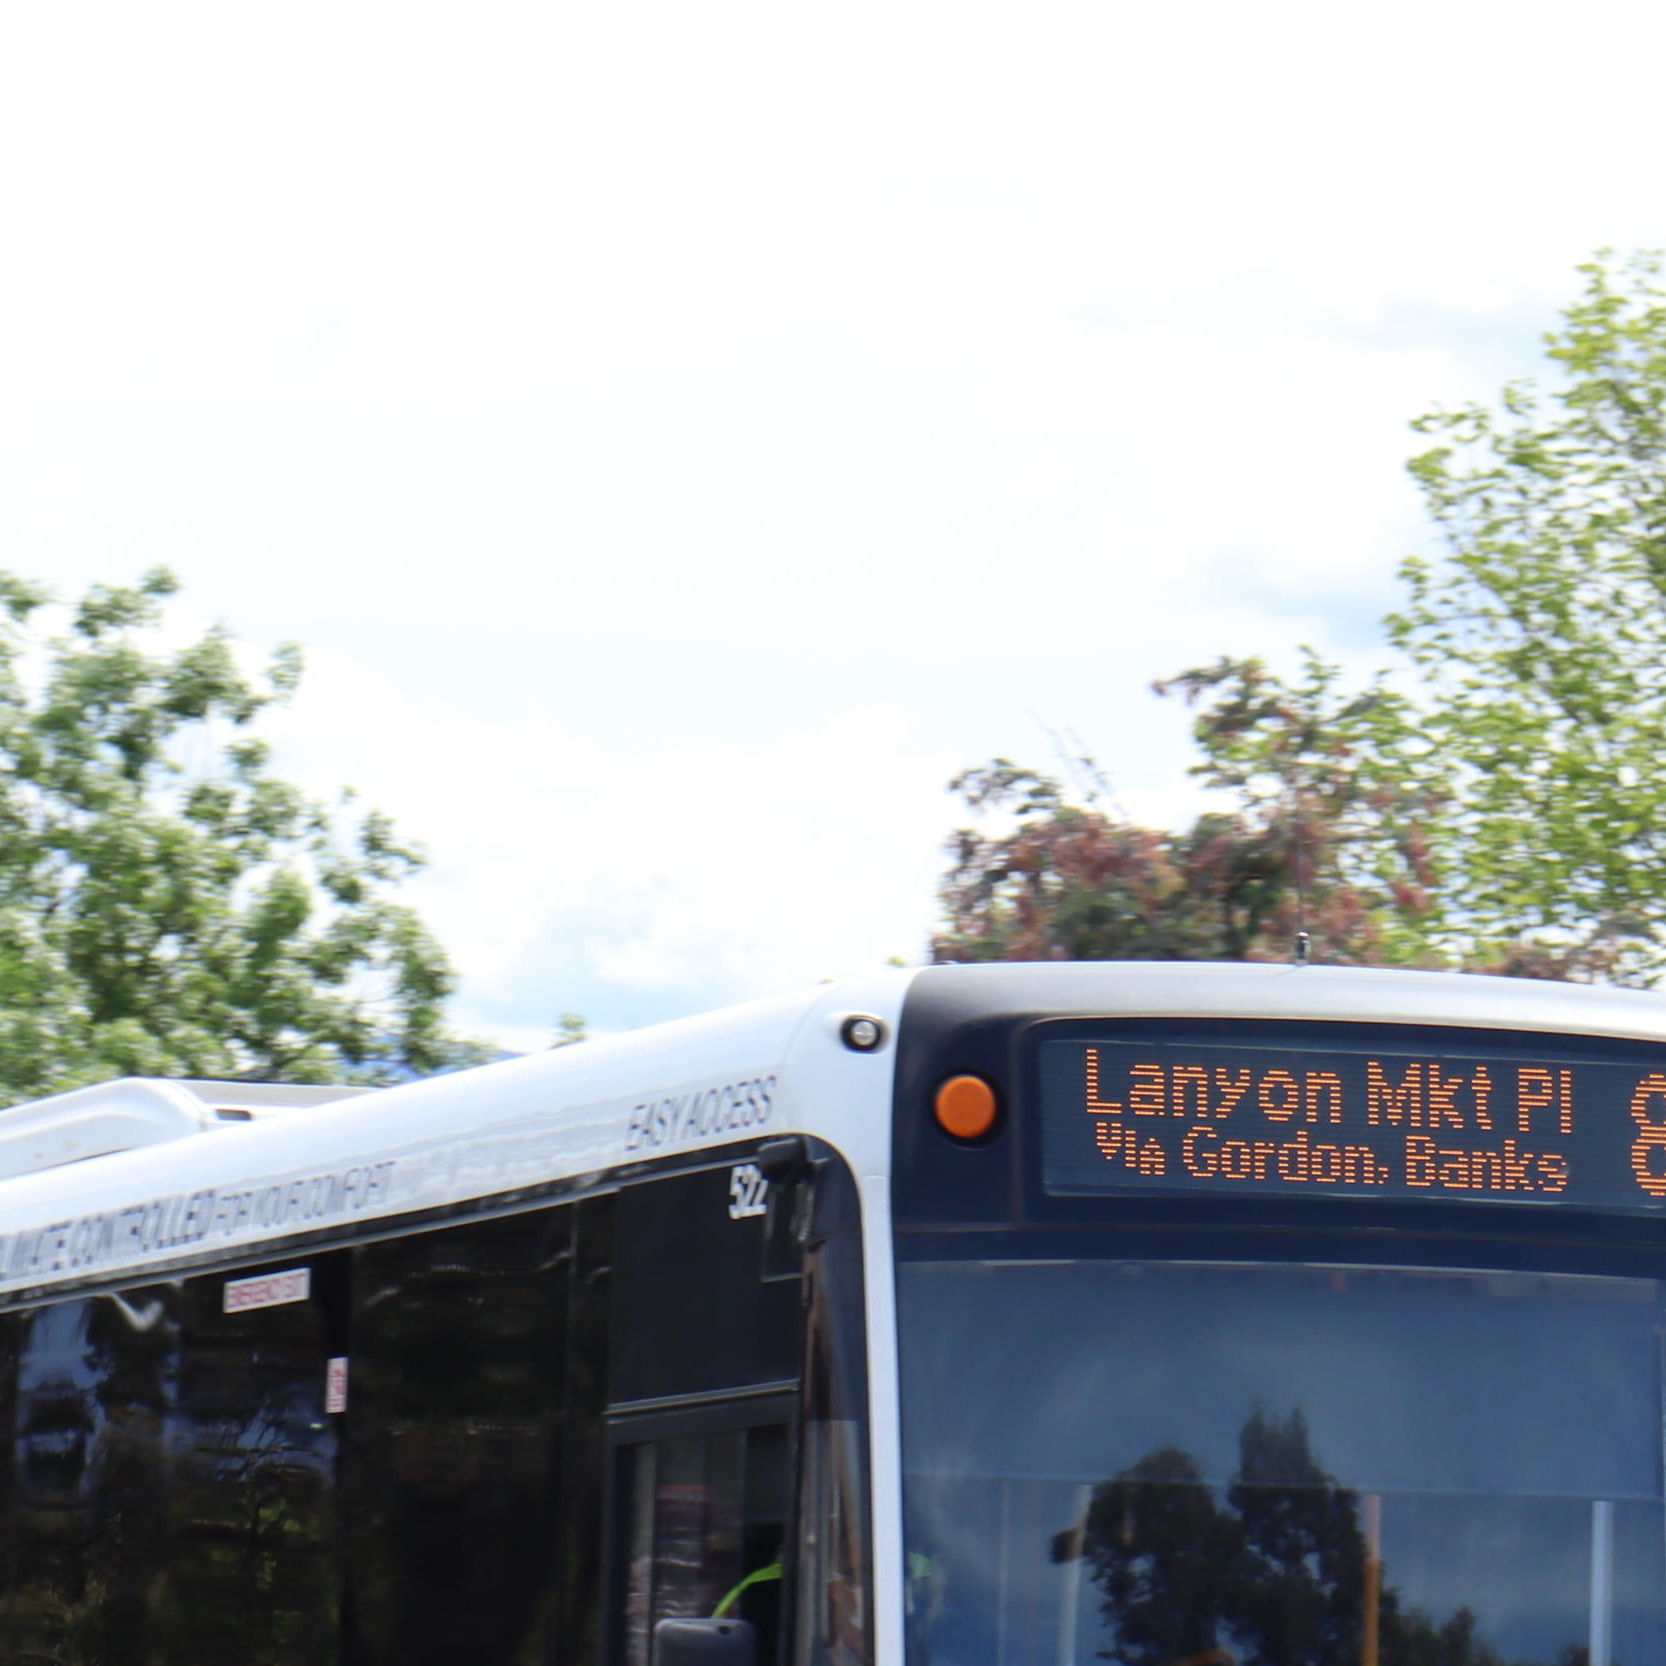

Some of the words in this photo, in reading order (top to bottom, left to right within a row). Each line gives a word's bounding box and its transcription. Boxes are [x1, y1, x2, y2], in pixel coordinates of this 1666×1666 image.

[1085, 1048, 1342, 1123] Lanyon
[1367, 1060, 1493, 1131] Mkt
[1517, 1067, 1573, 1135] Pl
[1182, 1125, 1390, 1186] Gordon,
[1405, 1134, 1569, 1192] Banks
